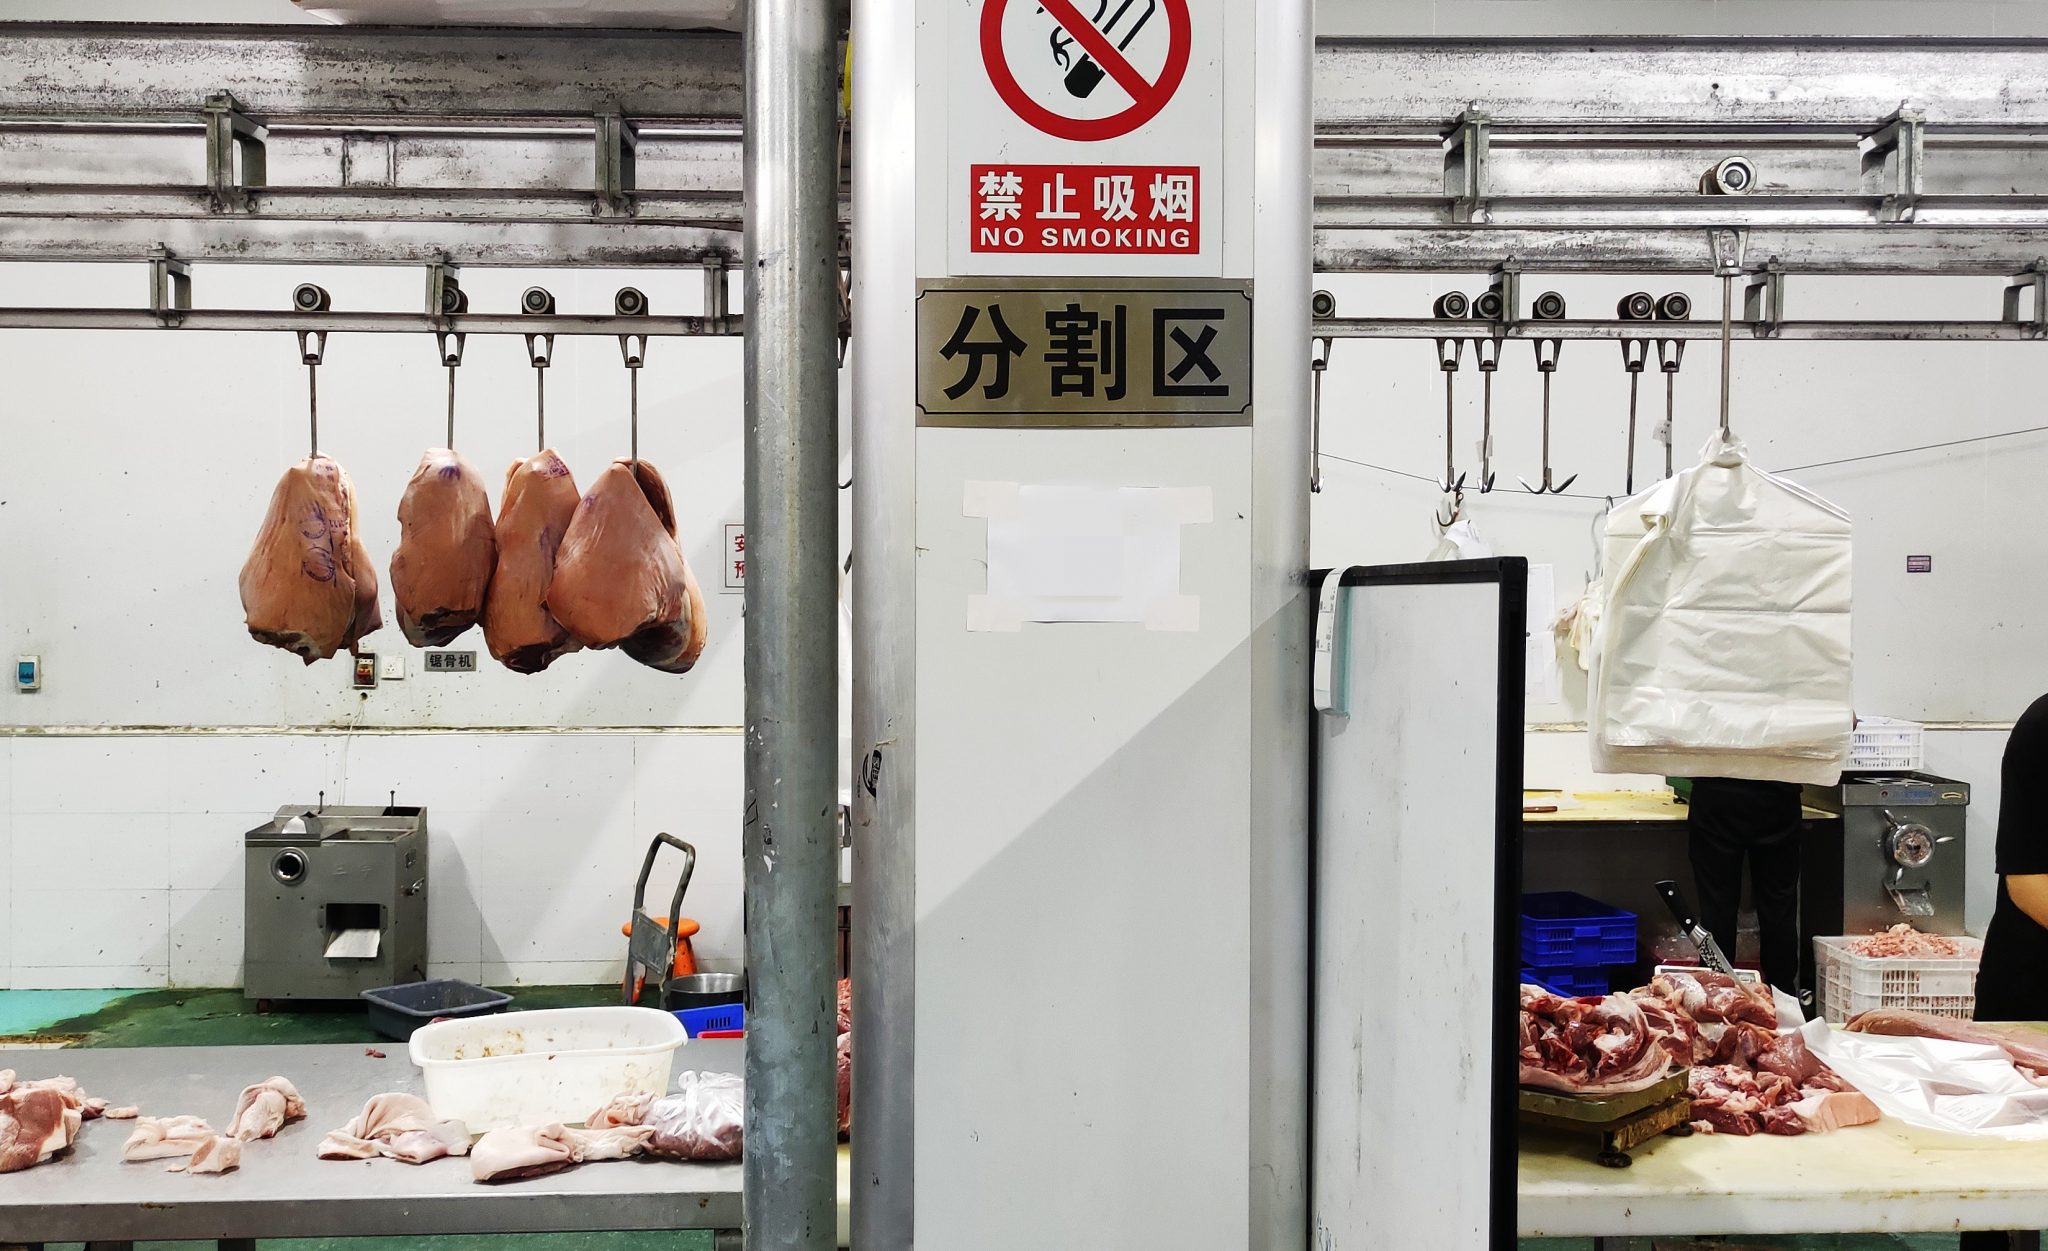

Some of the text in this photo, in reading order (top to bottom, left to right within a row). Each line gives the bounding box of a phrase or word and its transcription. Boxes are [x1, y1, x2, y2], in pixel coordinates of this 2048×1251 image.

[978, 171, 1194, 223] 禁止吸烟
[980, 227, 1190, 248] NO SMOKING
[939, 303, 1230, 401] 分割区
[429, 654, 472, 668] 锯骨机
